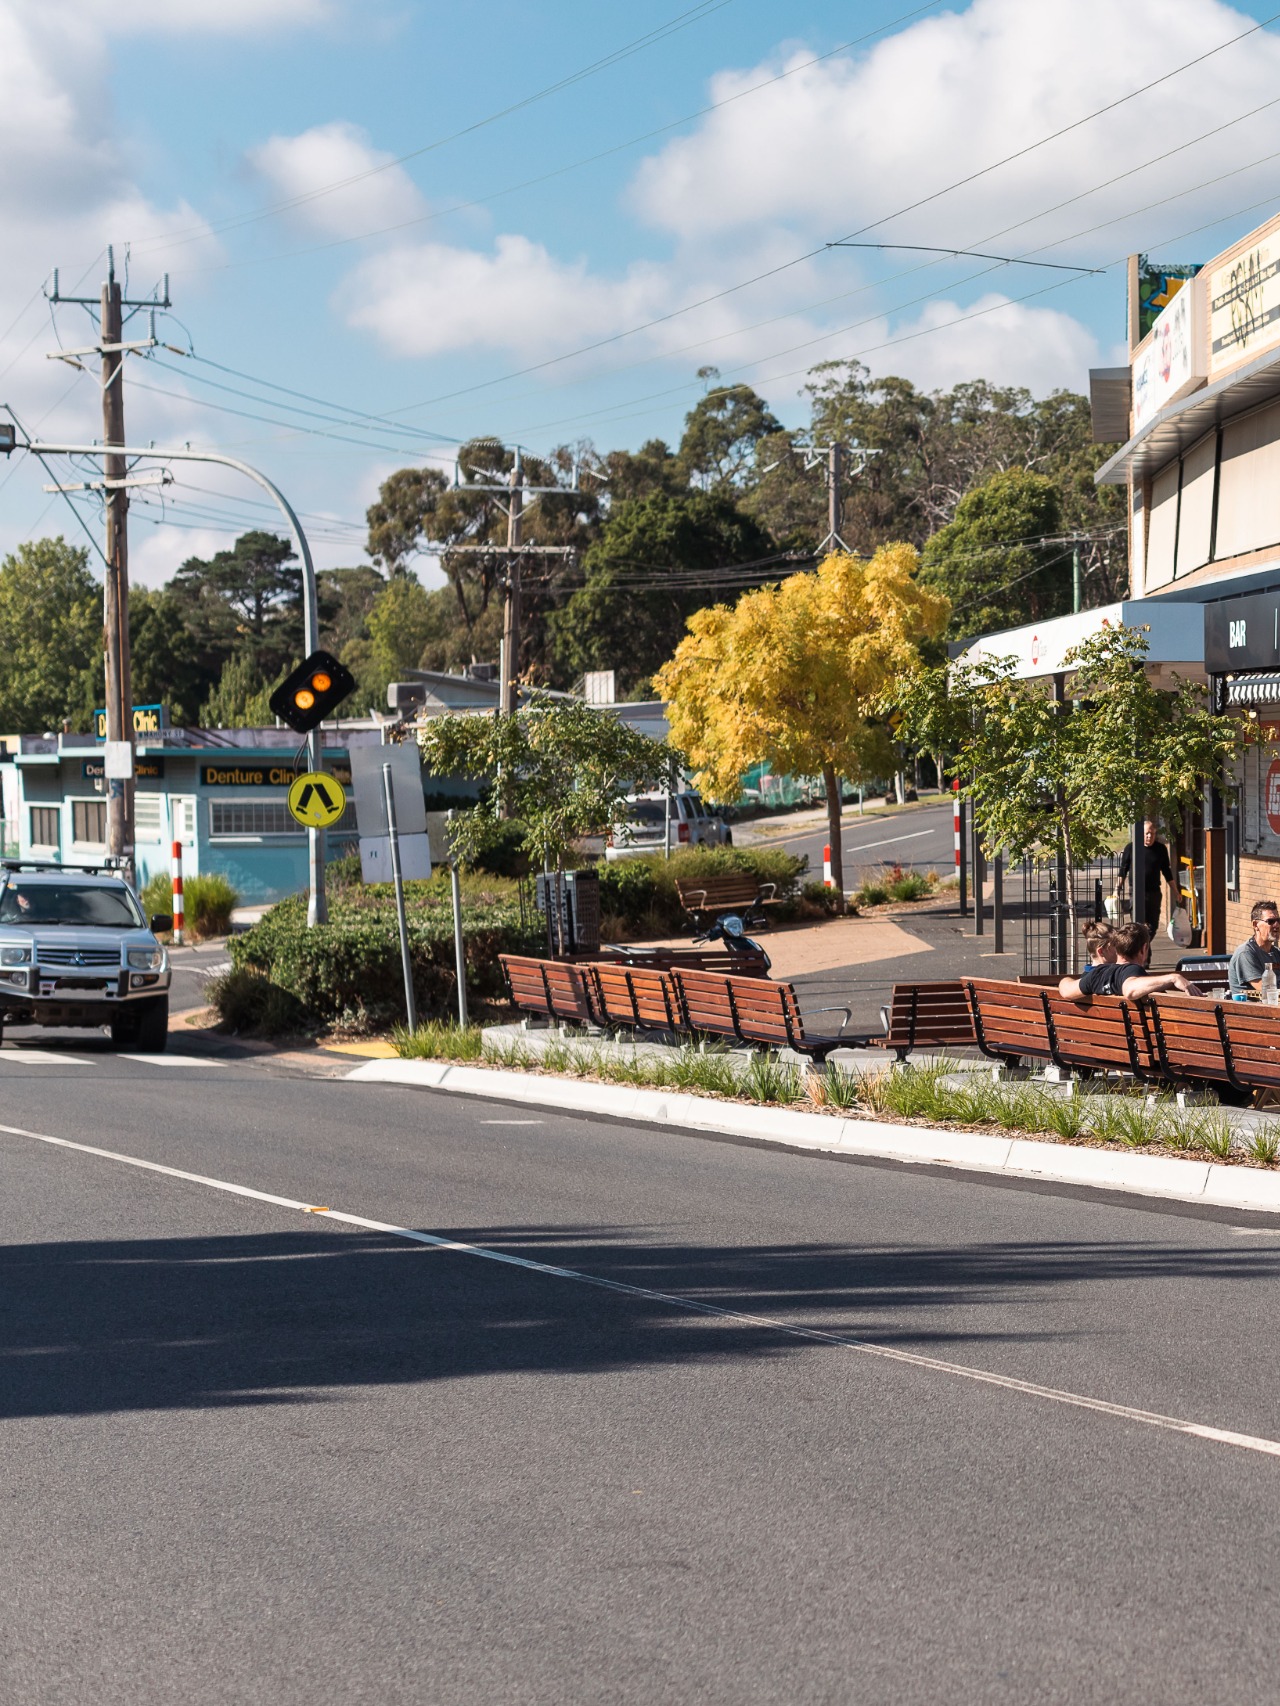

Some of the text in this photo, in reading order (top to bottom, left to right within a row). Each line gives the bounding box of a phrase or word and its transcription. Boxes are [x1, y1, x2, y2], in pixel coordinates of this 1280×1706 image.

[1229, 619, 1247, 648] BAR
[132, 709, 158, 733] Clinic
[206, 768, 304, 785] Denture Clin
